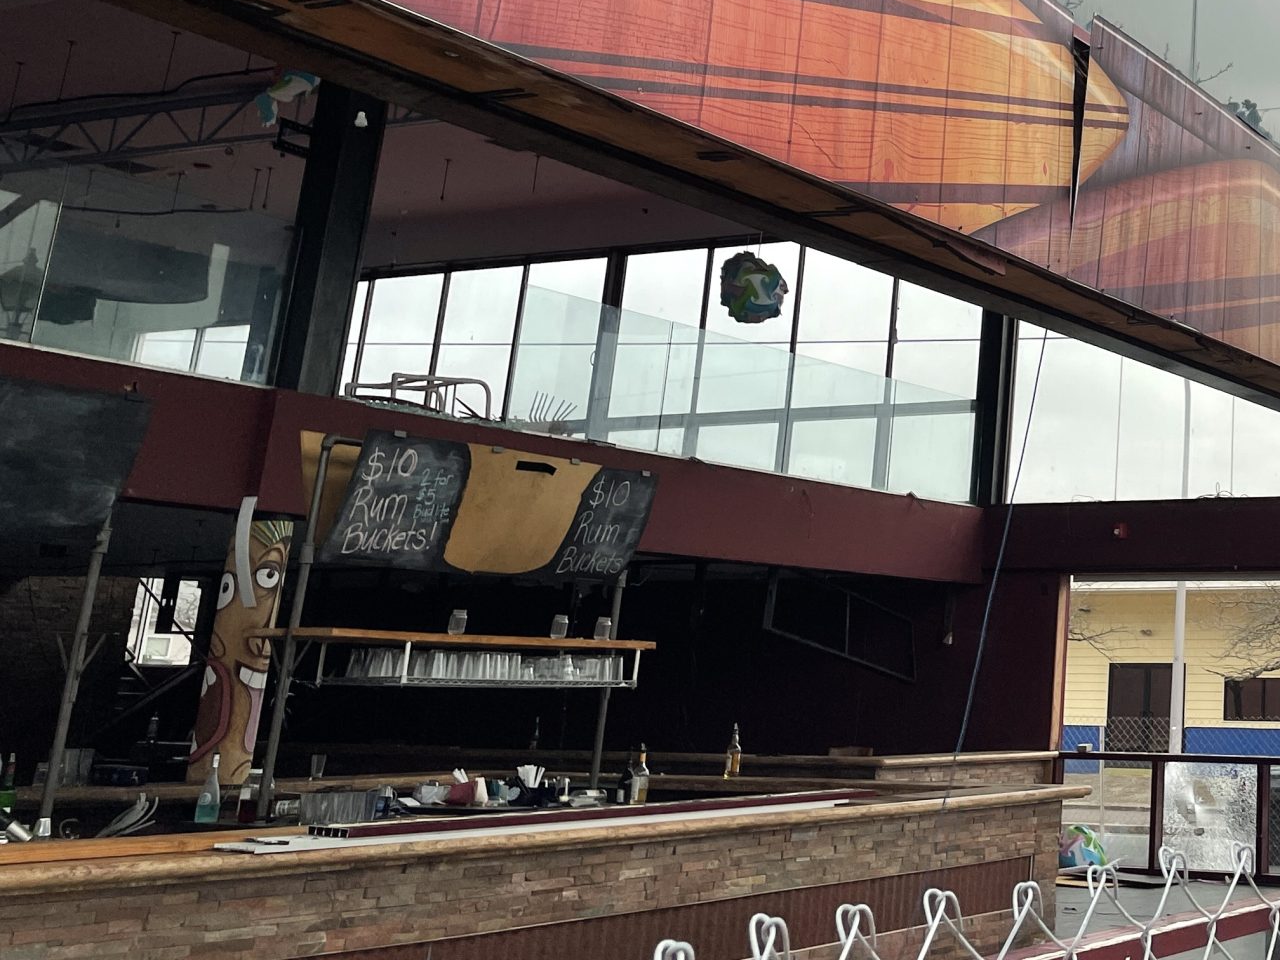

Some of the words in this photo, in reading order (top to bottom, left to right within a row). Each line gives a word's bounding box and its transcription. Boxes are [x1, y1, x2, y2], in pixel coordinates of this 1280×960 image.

[361, 446, 418, 487] $10
[420, 467, 432, 487] 2
[433, 469, 455, 488] for
[349, 486, 408, 527] Rum
[415, 487, 437, 506] $5
[588, 474, 631, 509] $10
[340, 519, 438, 554] Buckets!
[573, 510, 620, 545] Rum
[554, 545, 624, 574] Buckets
